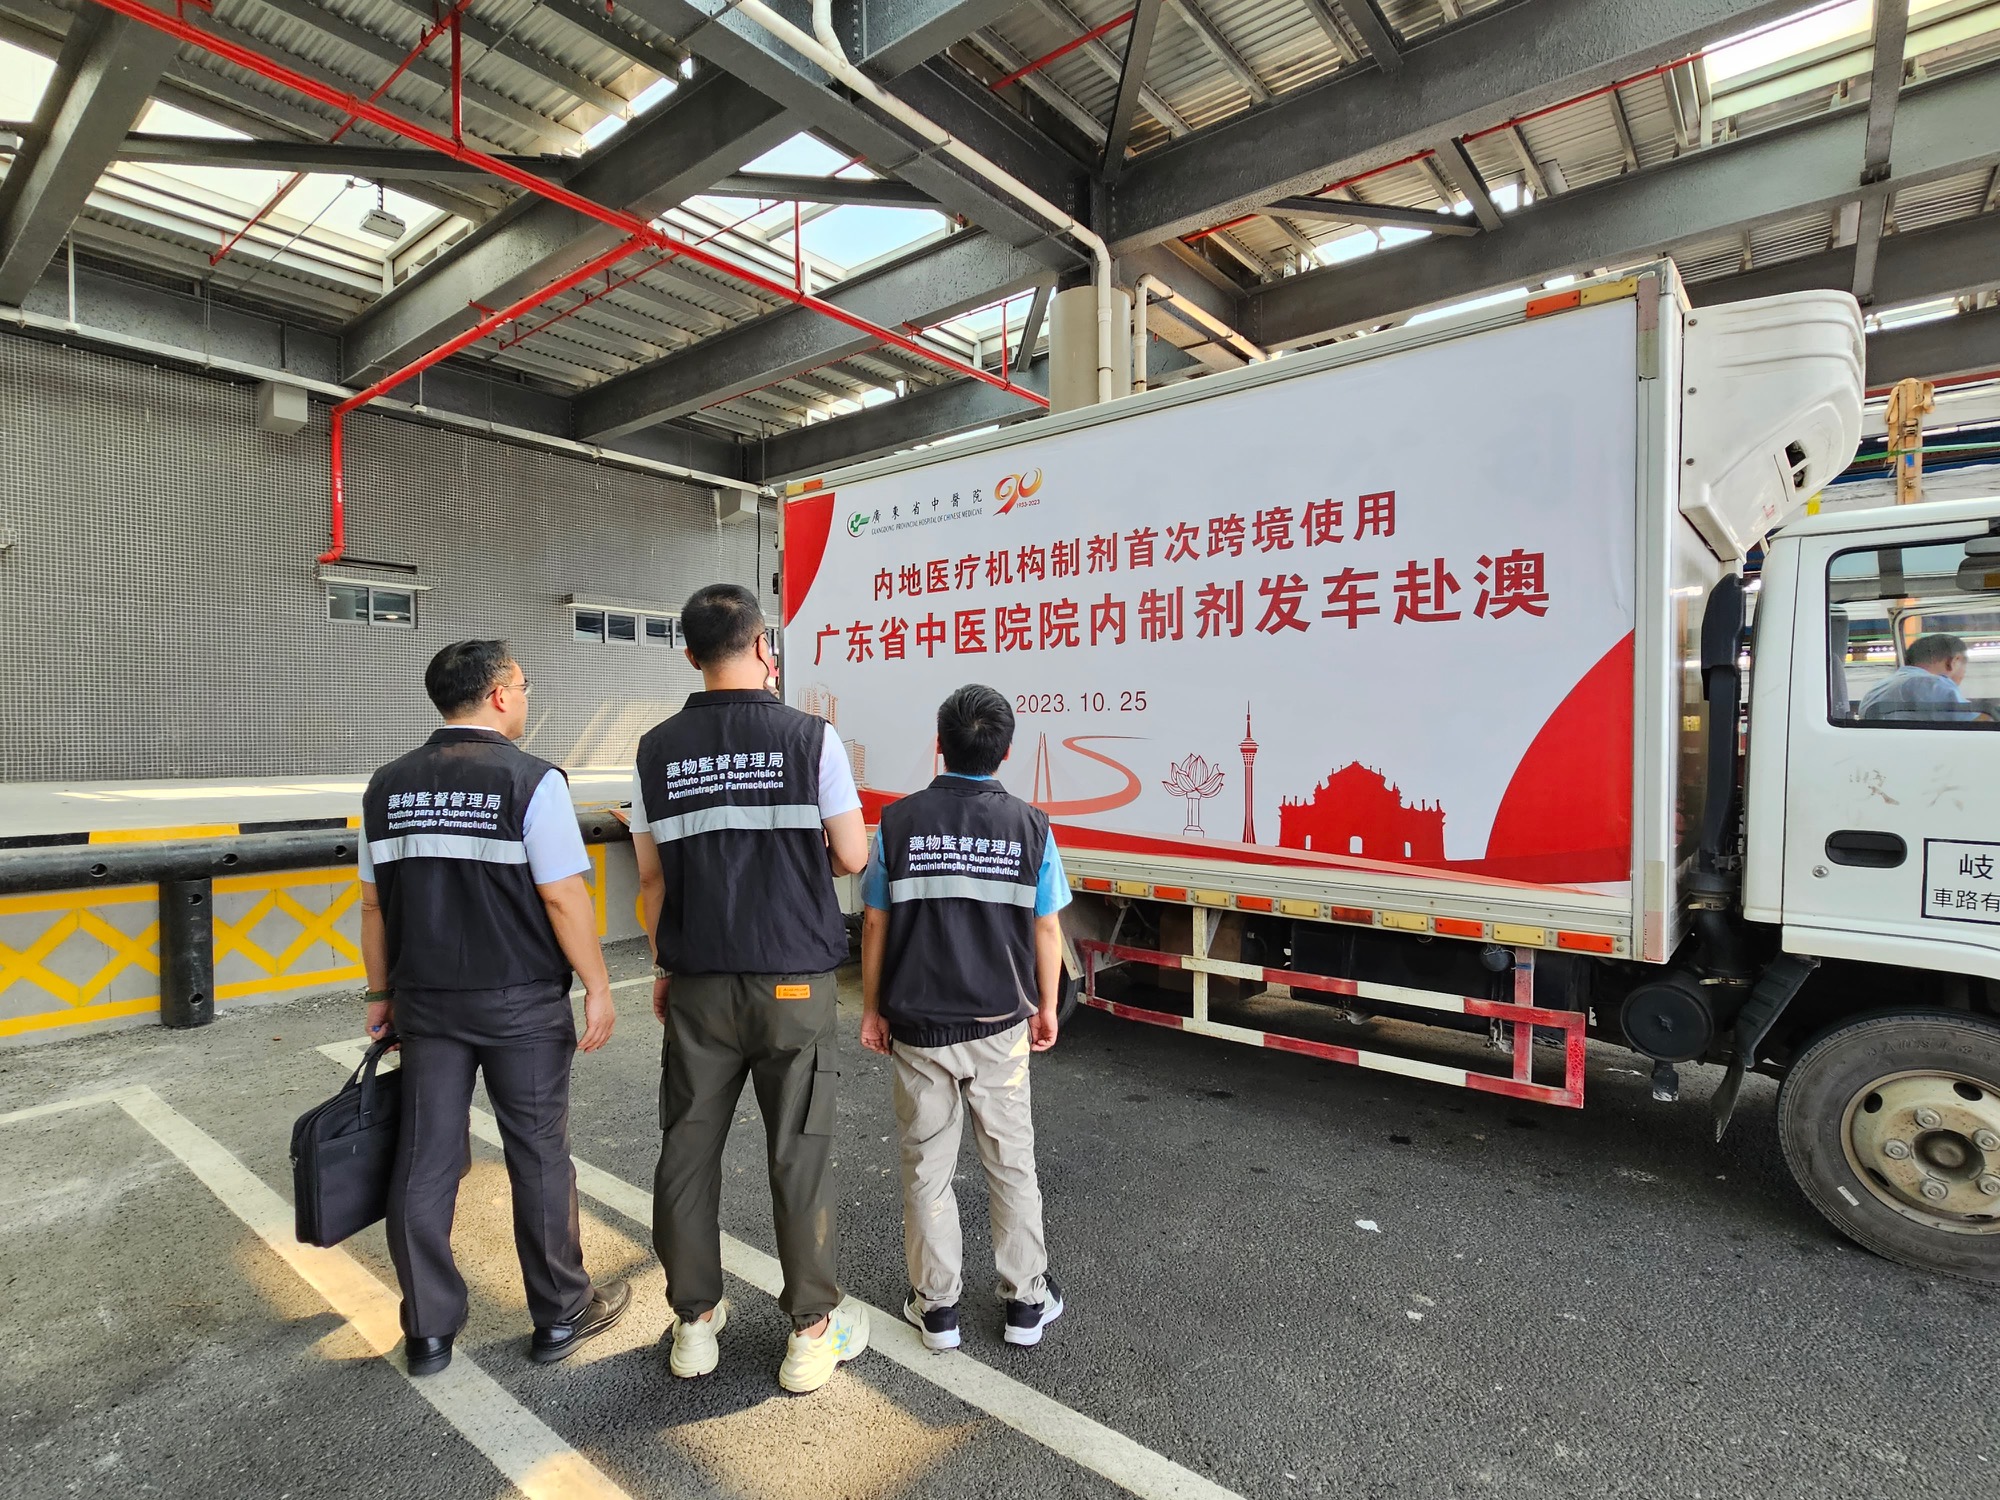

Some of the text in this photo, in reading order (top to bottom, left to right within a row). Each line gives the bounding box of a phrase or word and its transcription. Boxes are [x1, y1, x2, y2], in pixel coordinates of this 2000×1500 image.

[872, 488, 983, 524] 廣東省中醫院
[919, 516, 937, 526] HOSPITAL
[961, 508, 983, 518] MEDICINE
[874, 490, 1396, 601] 内地医疗机构制剂首次跨境使用
[813, 548, 1550, 666] 广东省中医院院内制剂发车赴澳
[1016, 691, 1147, 713] 2023. 10. 25
[666, 752, 784, 778] 藥物監督管理局
[667, 777, 699, 789] Instituto
[700, 774, 718, 784] para
[727, 769, 776, 781] Supervisão
[387, 791, 501, 810] 藥物監督管理局
[668, 780, 784, 800] Administração Farmacêutica
[387, 809, 413, 820] Instituto
[414, 809, 434, 818] para
[441, 808, 491, 818] Supervisão
[388, 818, 497, 830] Administração Farmacêutica
[909, 835, 1022, 858] 藥物監督管理局
[909, 852, 942, 861] Instituto
[943, 853, 960, 861] para
[969, 853, 1013, 866] Supervisão
[909, 862, 1019, 877] Administração Farmacêutica
[1959, 854, 1994, 880] 岐
[1932, 888, 2000, 912] 車路有
